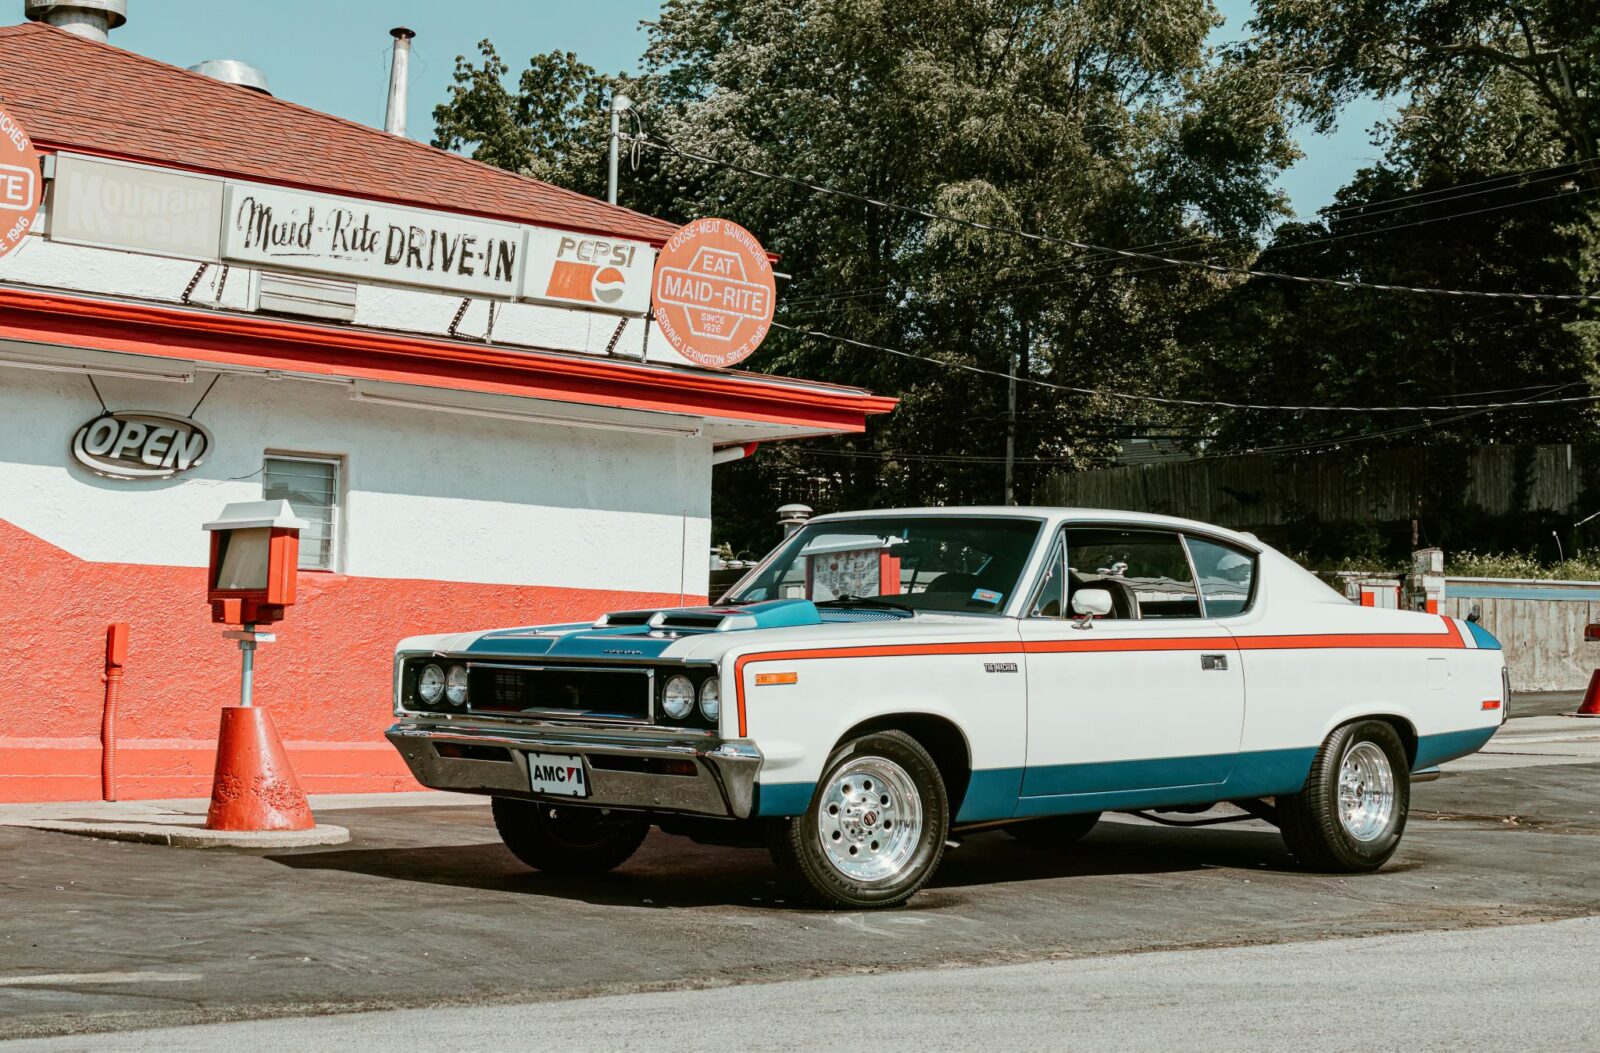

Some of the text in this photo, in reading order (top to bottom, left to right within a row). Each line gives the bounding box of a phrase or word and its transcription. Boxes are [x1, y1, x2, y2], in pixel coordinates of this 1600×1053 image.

[7, 216, 29, 242] 1946
[384, 222, 517, 282] DRIVE-IN
[557, 237, 636, 268] PEPSI
[668, 220, 769, 271] LOOSE-MEAT SANDWICHES
[703, 254, 735, 275] EAT
[664, 275, 764, 313] MAID-RITE
[700, 312, 726, 325] SINCE
[703, 322, 721, 333] 1926
[656, 307, 766, 364] SERVING LEXINGTON SINCE 1946
[84, 417, 203, 470] OPEN
[984, 662, 995, 673] THE
[534, 765, 566, 782] AMC
